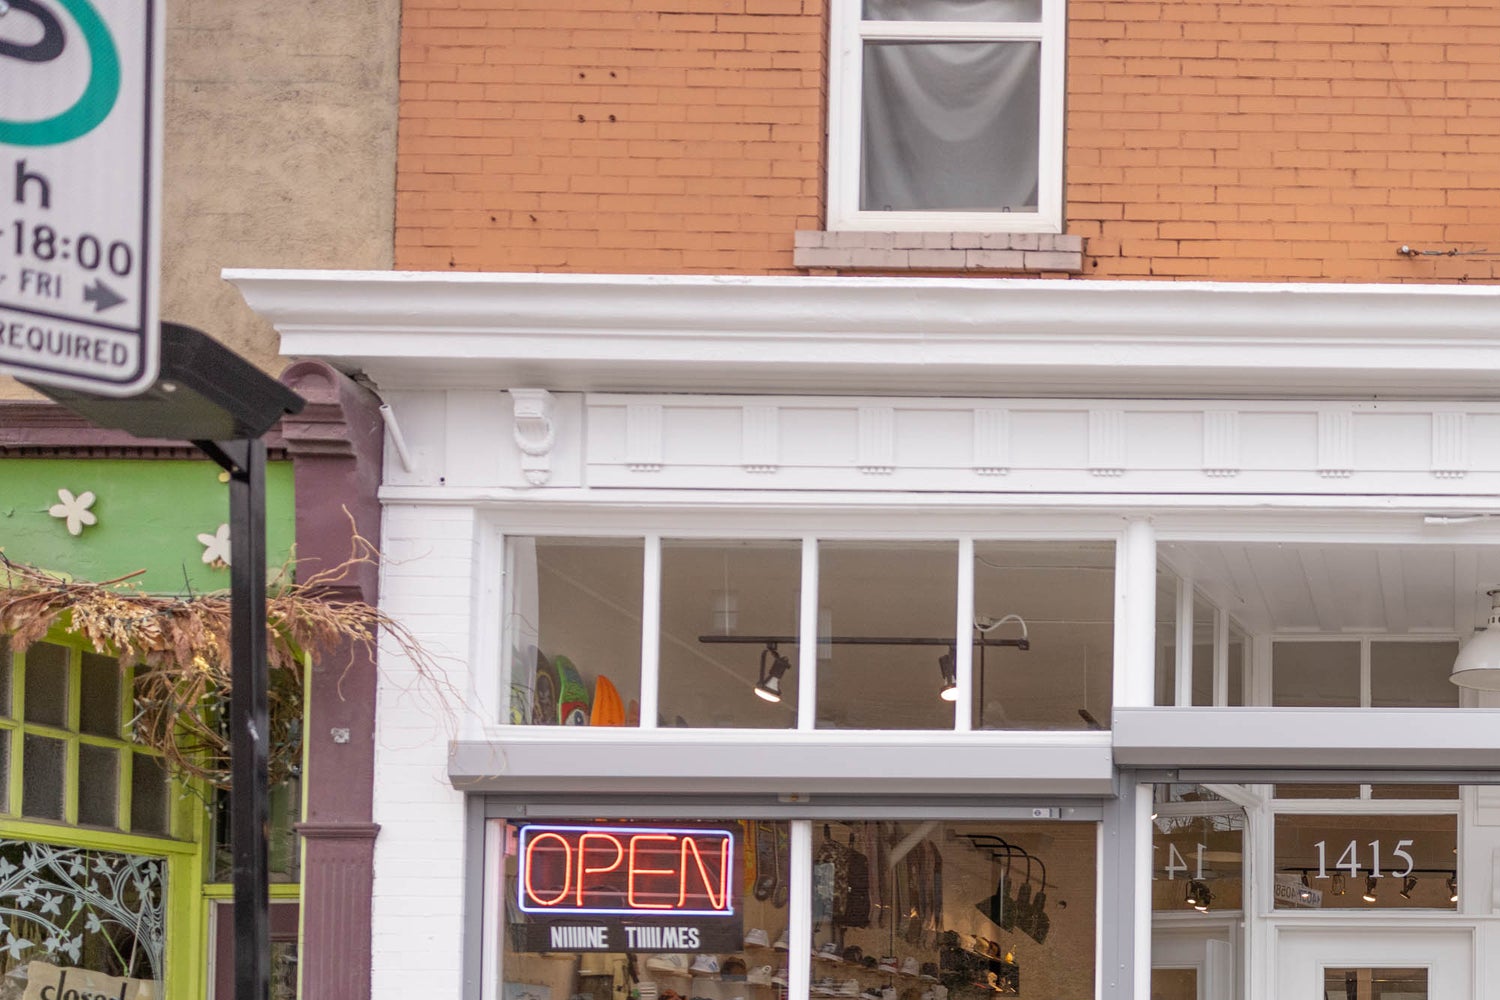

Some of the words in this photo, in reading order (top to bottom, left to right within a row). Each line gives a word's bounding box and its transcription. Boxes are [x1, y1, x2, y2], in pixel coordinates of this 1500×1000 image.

[20, 268, 62, 299] FRI
[0, 321, 129, 366] EQUIRED
[524, 832, 730, 910] OPEN
[1314, 839, 1414, 879] 1415
